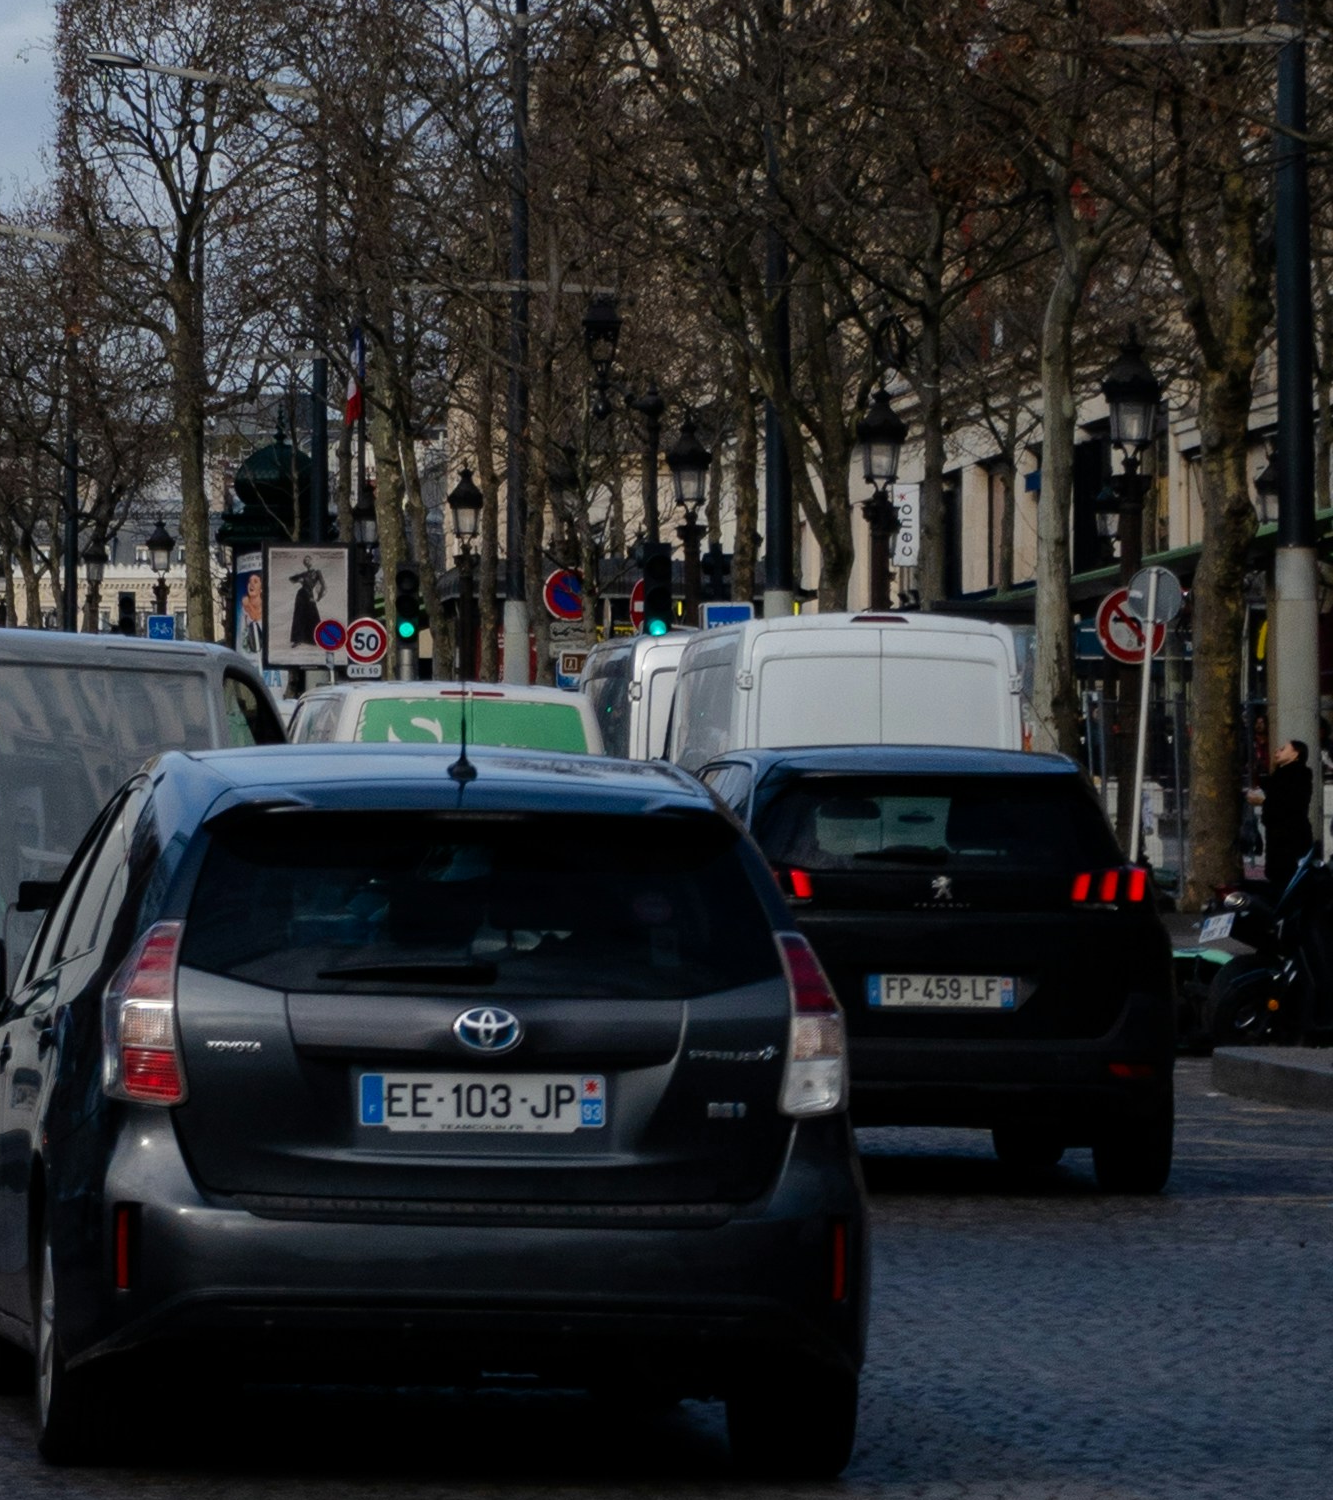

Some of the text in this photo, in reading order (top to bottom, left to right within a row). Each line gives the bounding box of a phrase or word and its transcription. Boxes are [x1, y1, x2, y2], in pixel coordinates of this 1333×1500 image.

[353, 632, 379, 652] 50
[885, 977, 998, 1001] FP-459-LF
[205, 1040, 263, 1052] TOYOTA
[386, 1083, 576, 1119] EE-103-JP
[582, 1103, 602, 1122] 93
